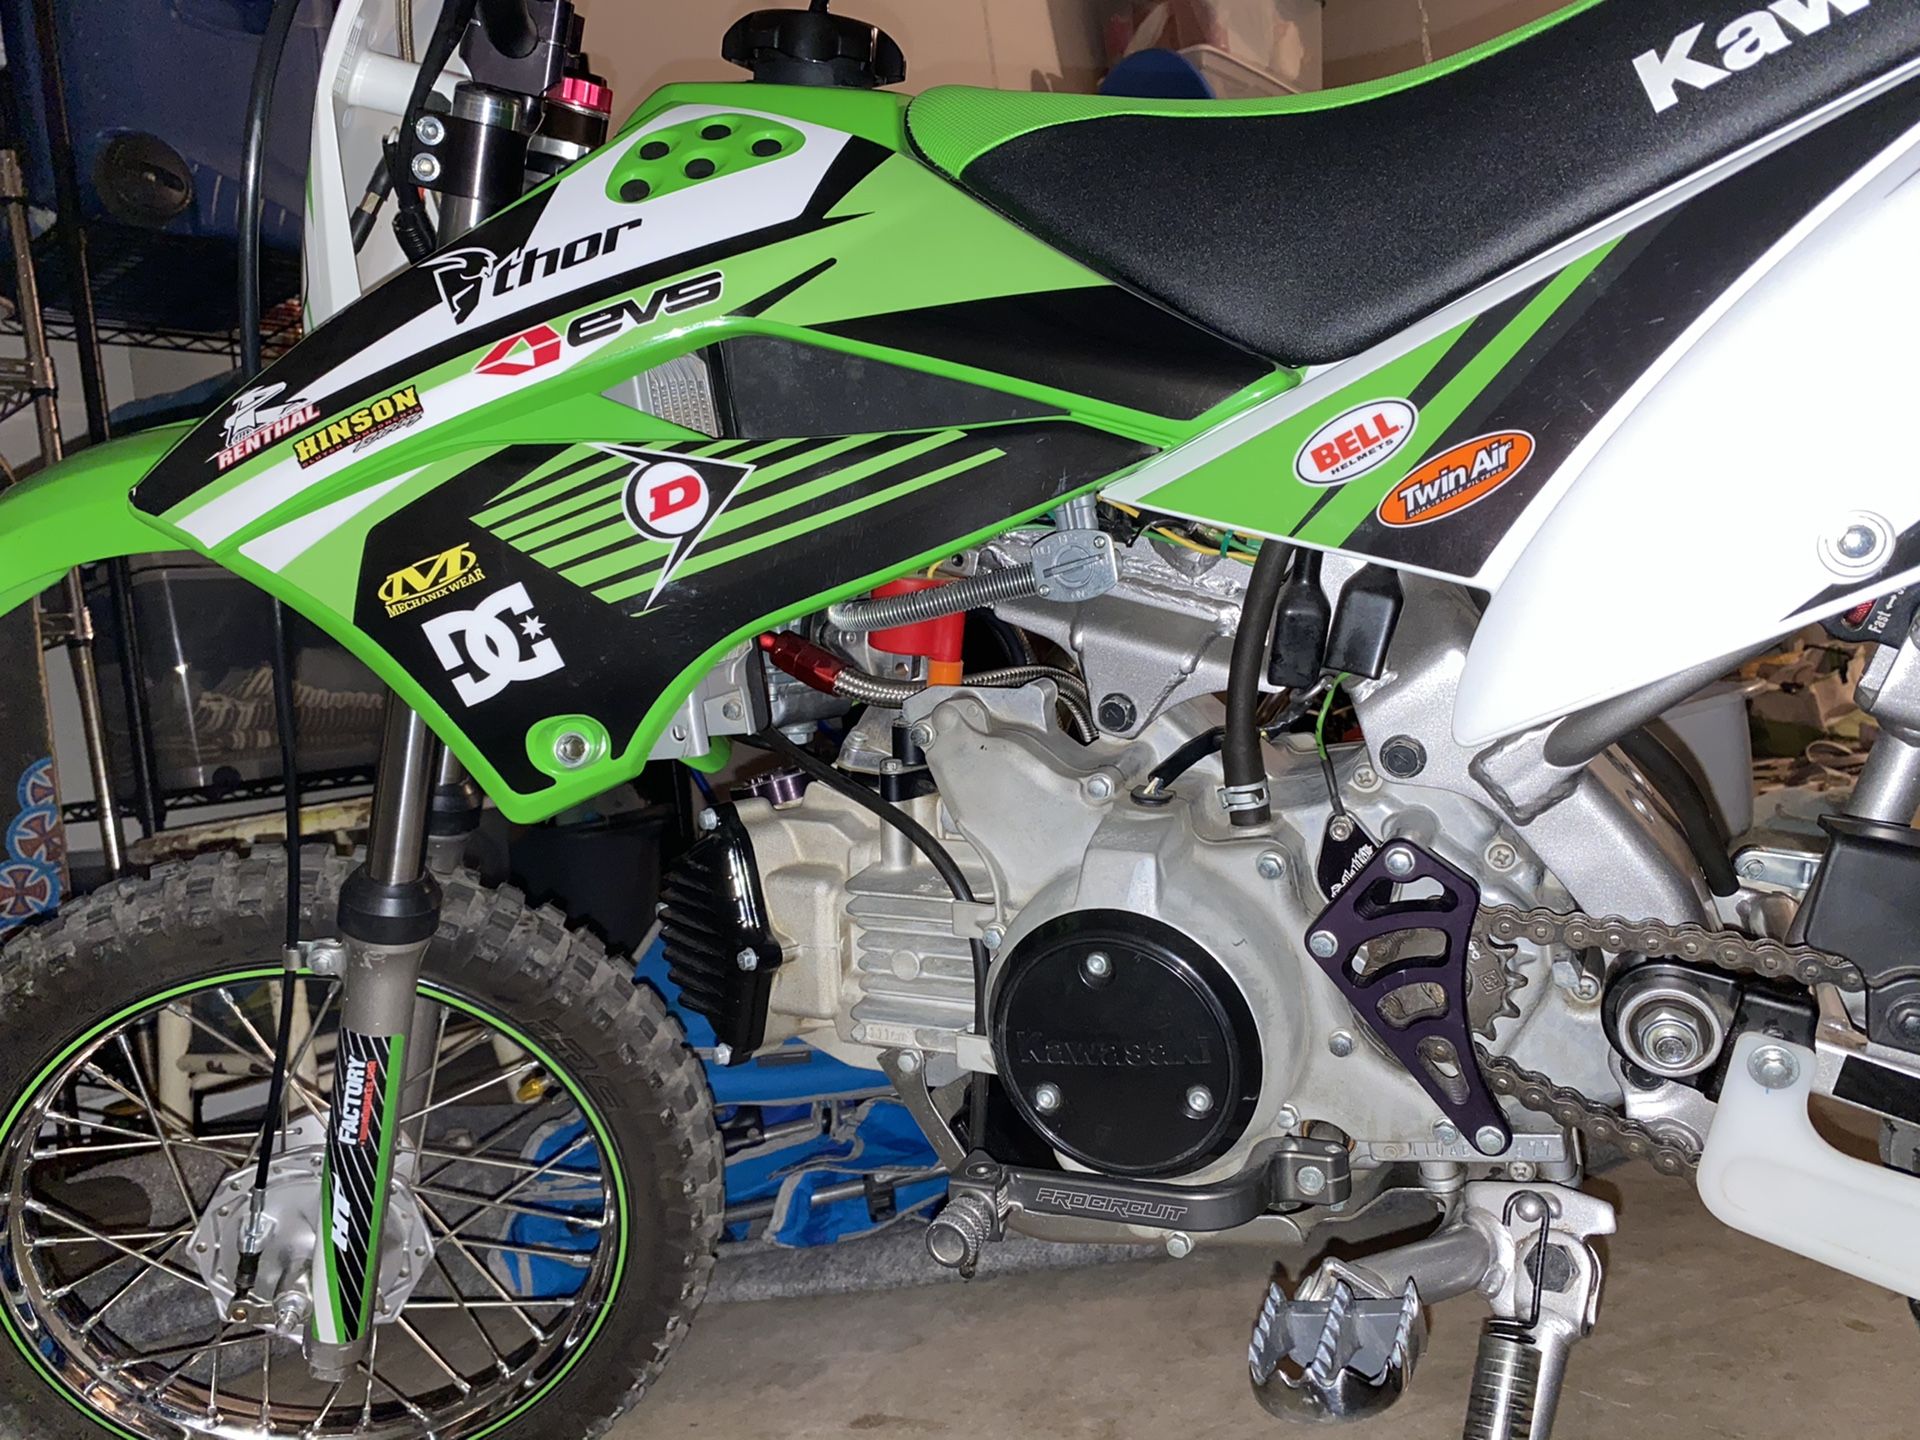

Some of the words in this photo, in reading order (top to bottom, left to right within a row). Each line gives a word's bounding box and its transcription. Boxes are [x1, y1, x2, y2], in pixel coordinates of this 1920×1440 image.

[492, 218, 642, 297] thor
[217, 403, 321, 471] RENTHAL
[294, 385, 418, 463] HINSON
[1310, 413, 1399, 473] BELL
[1331, 438, 1394, 475] HELMETS
[1399, 467, 1467, 513] Twin
[1470, 441, 1513, 480] Air
[1868, 611, 1892, 634] Fast
[1015, 1031, 1212, 1066] Kawasai
[338, 1054, 367, 1146] FACTORY
